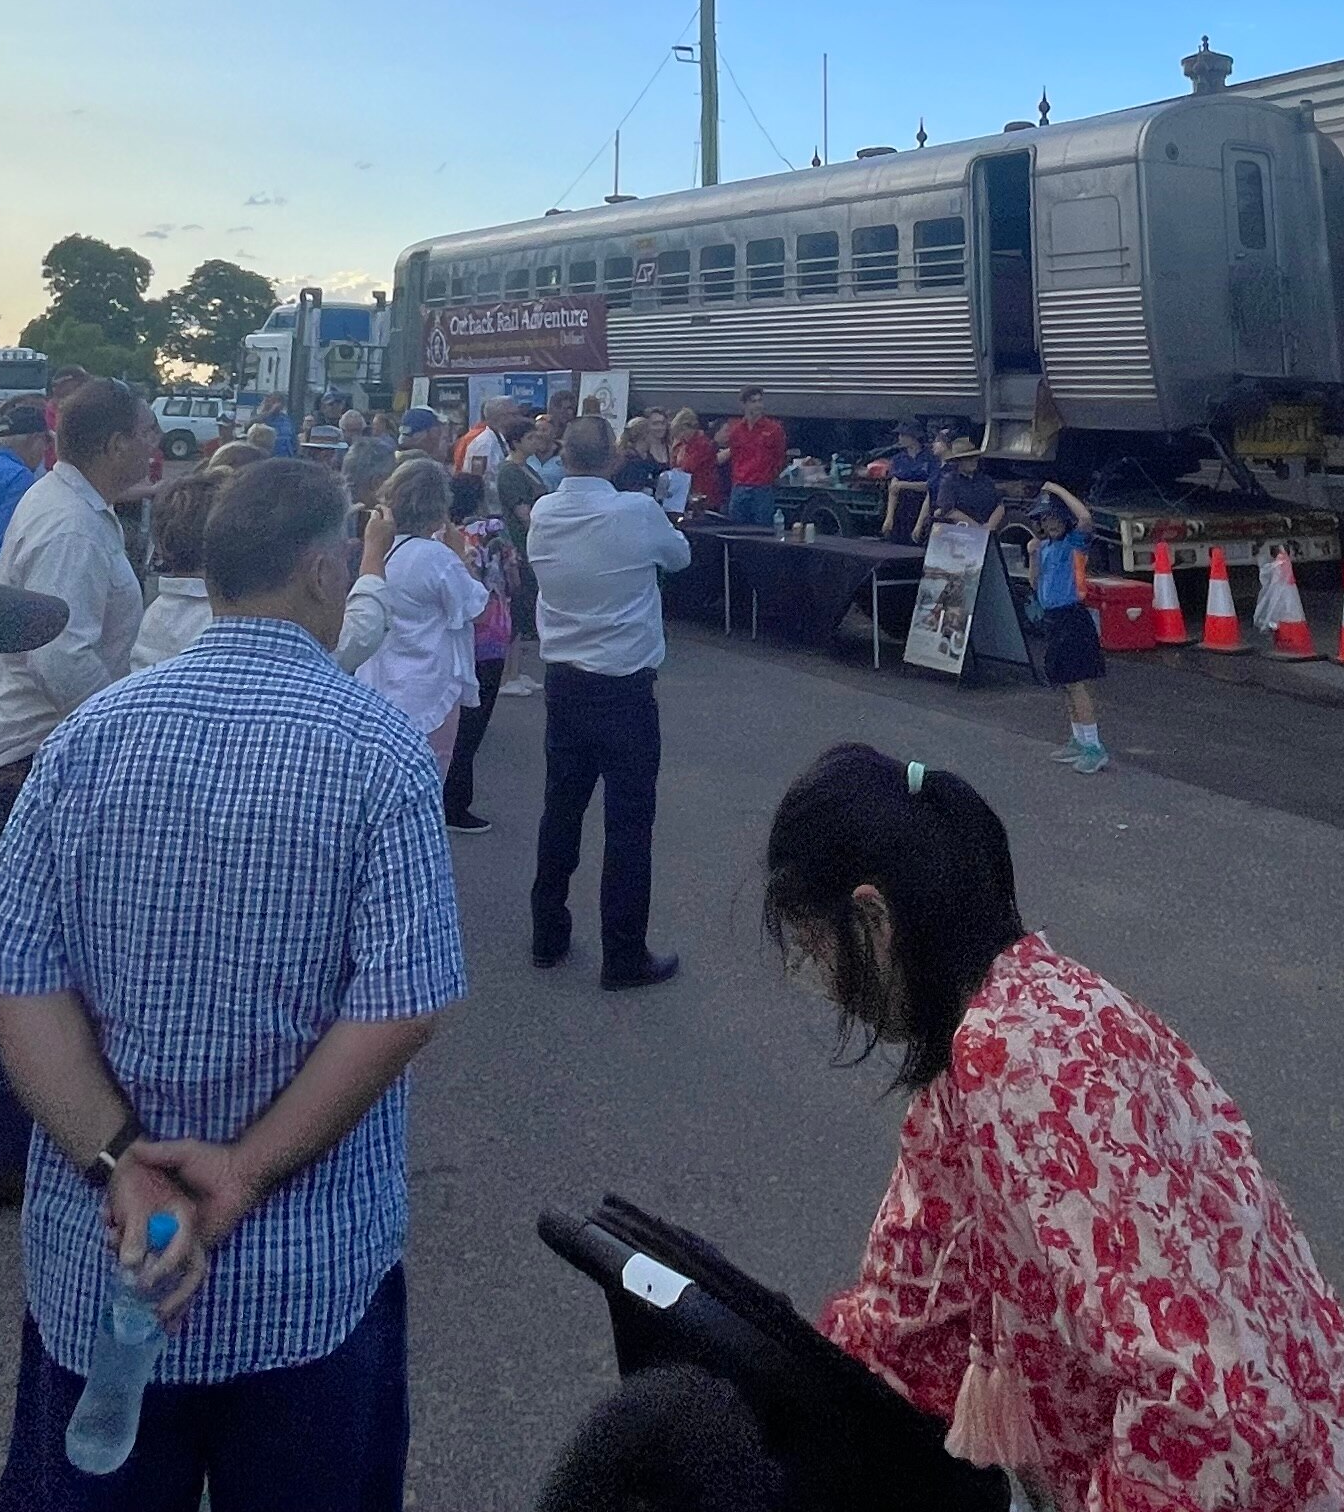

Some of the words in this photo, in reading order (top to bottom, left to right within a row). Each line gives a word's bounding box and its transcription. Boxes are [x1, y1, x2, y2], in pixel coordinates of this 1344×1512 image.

[450, 311, 495, 336] Outback
[496, 308, 520, 332] Rail
[522, 307, 589, 330] Adventure
